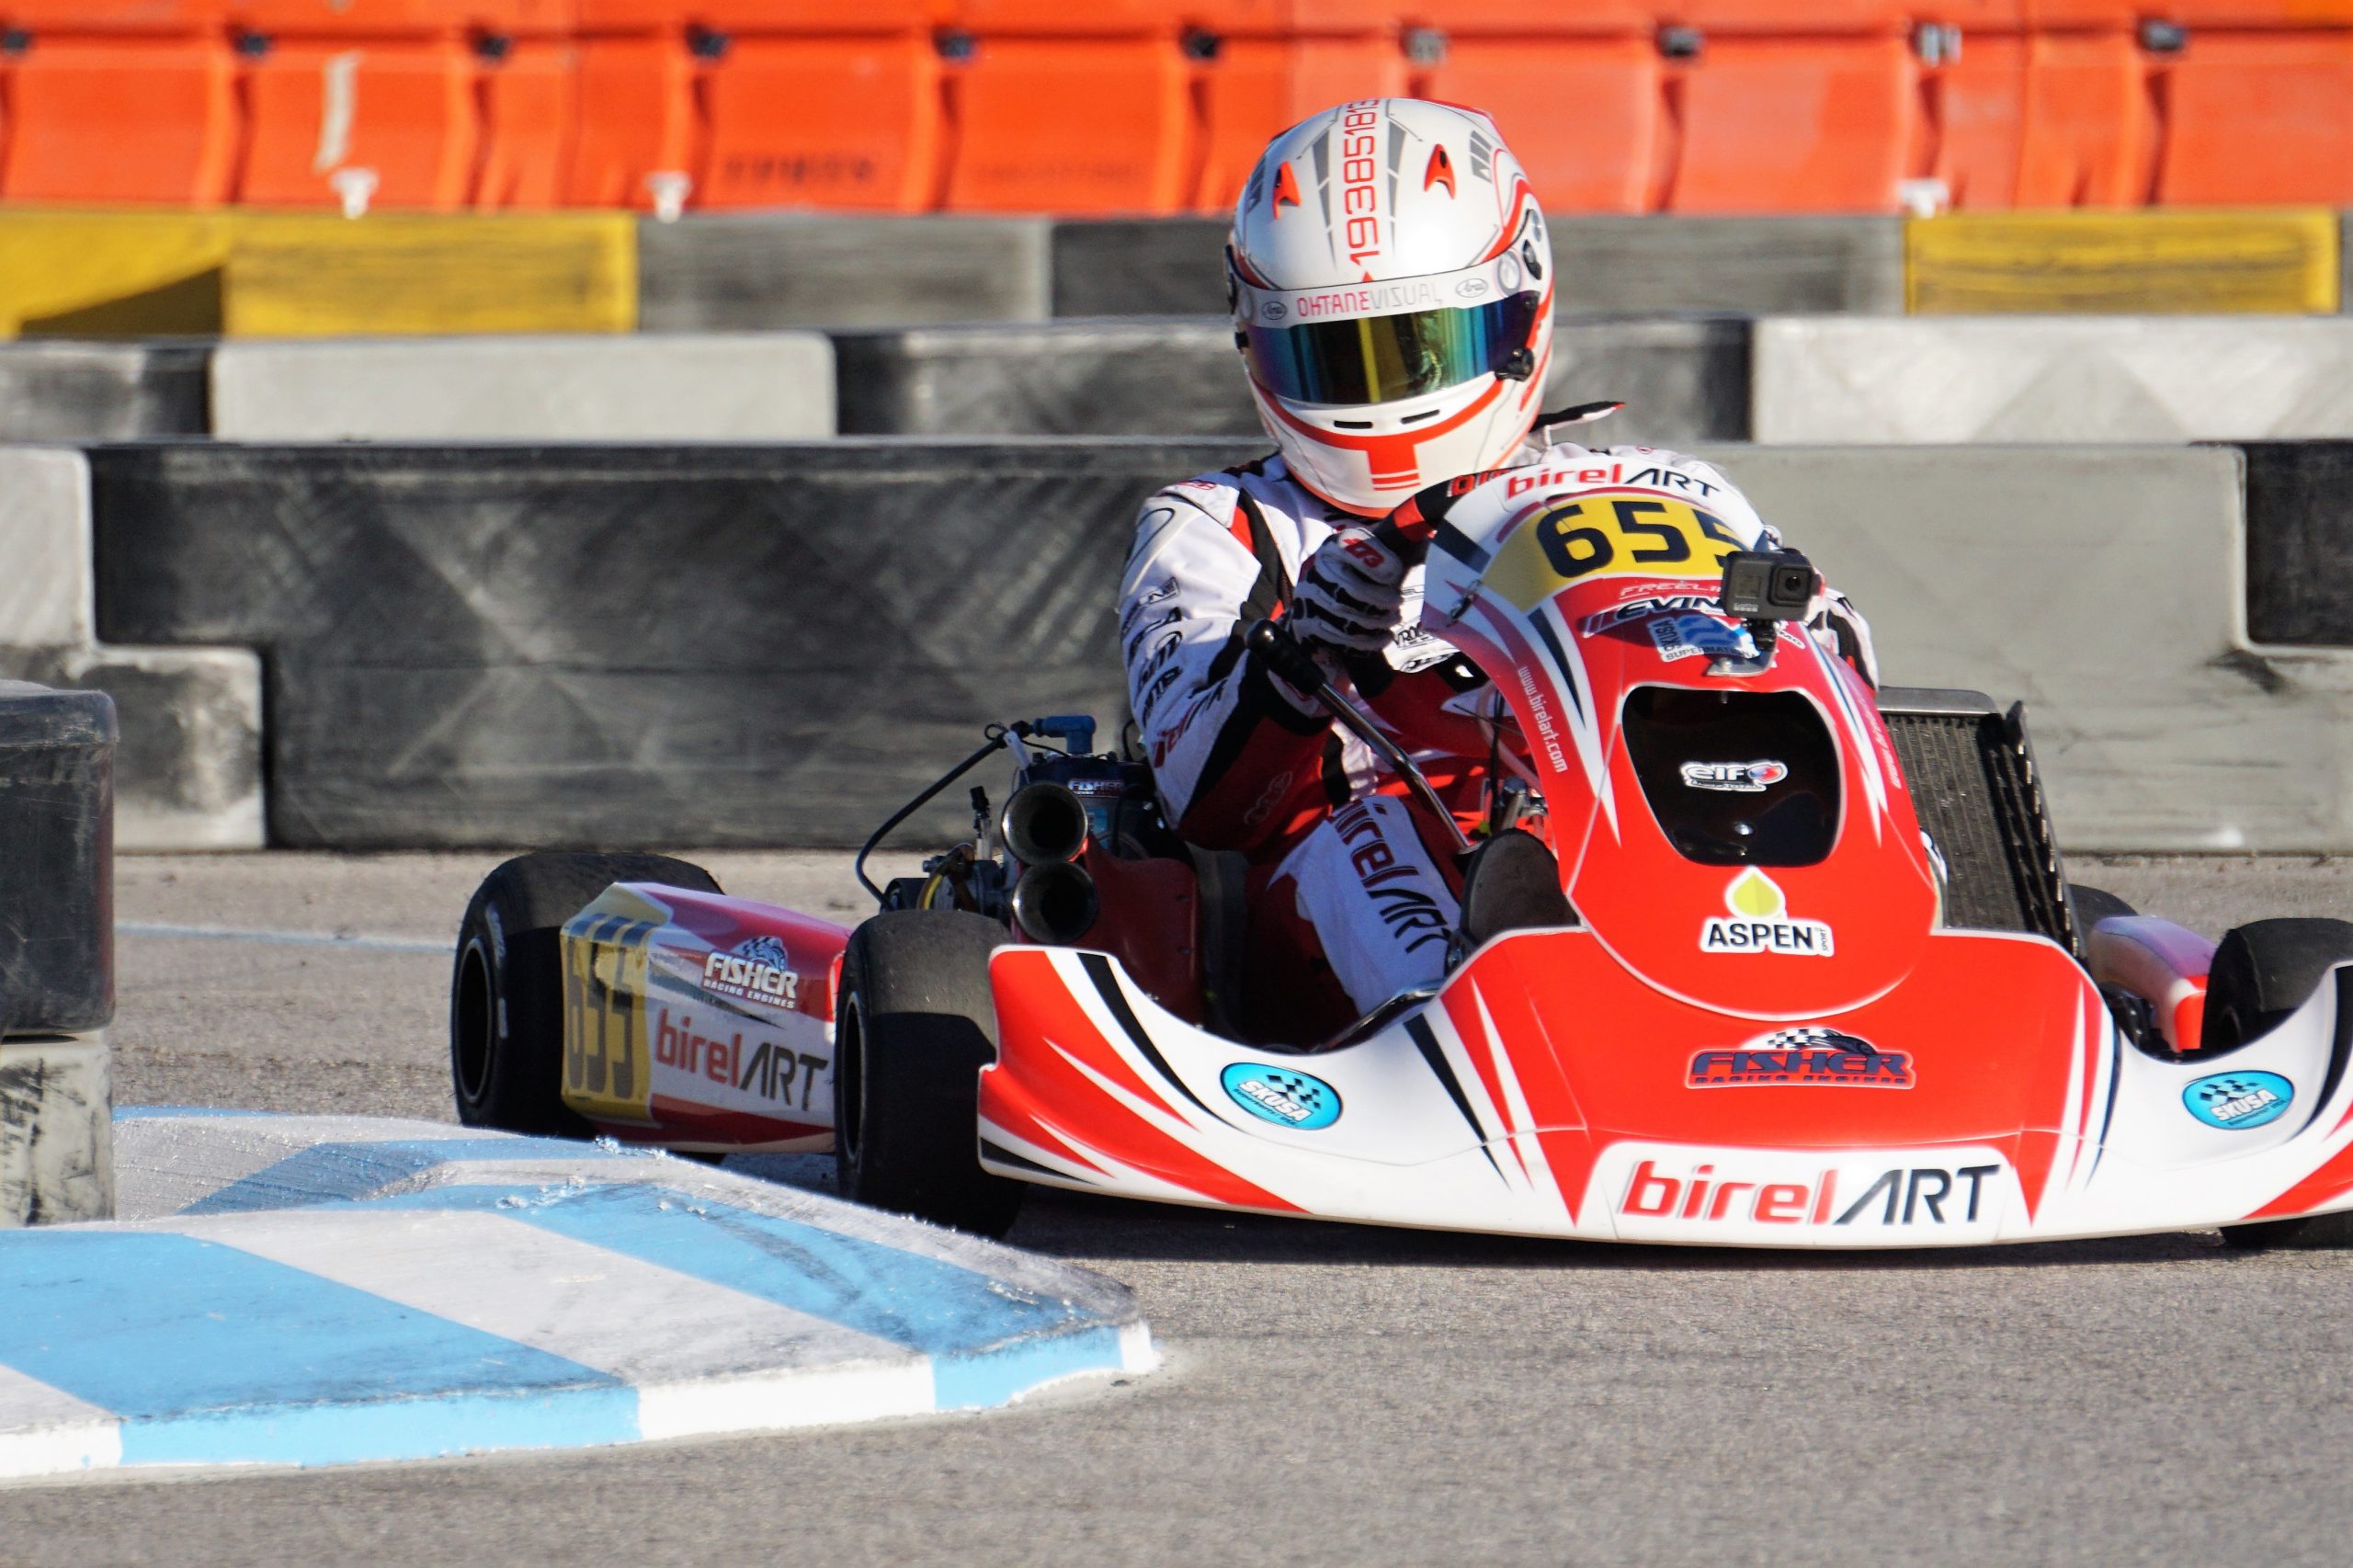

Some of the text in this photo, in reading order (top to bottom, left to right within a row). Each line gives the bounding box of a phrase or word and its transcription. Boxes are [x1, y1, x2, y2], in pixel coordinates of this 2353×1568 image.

[1505, 463, 1721, 500] birelART
[1620, 582, 1722, 597] FREELI
[1518, 665, 1569, 773] www.birelart.com
[1707, 923, 1814, 950] ASPEN
[704, 952, 799, 1000] FISHER
[655, 1008, 829, 1112] birelART
[1691, 1051, 1910, 1076] FISHER
[1238, 1079, 1313, 1122] SKUSA
[2209, 1088, 2279, 1122] SKUSA
[1618, 1160, 2001, 1226] birelART
